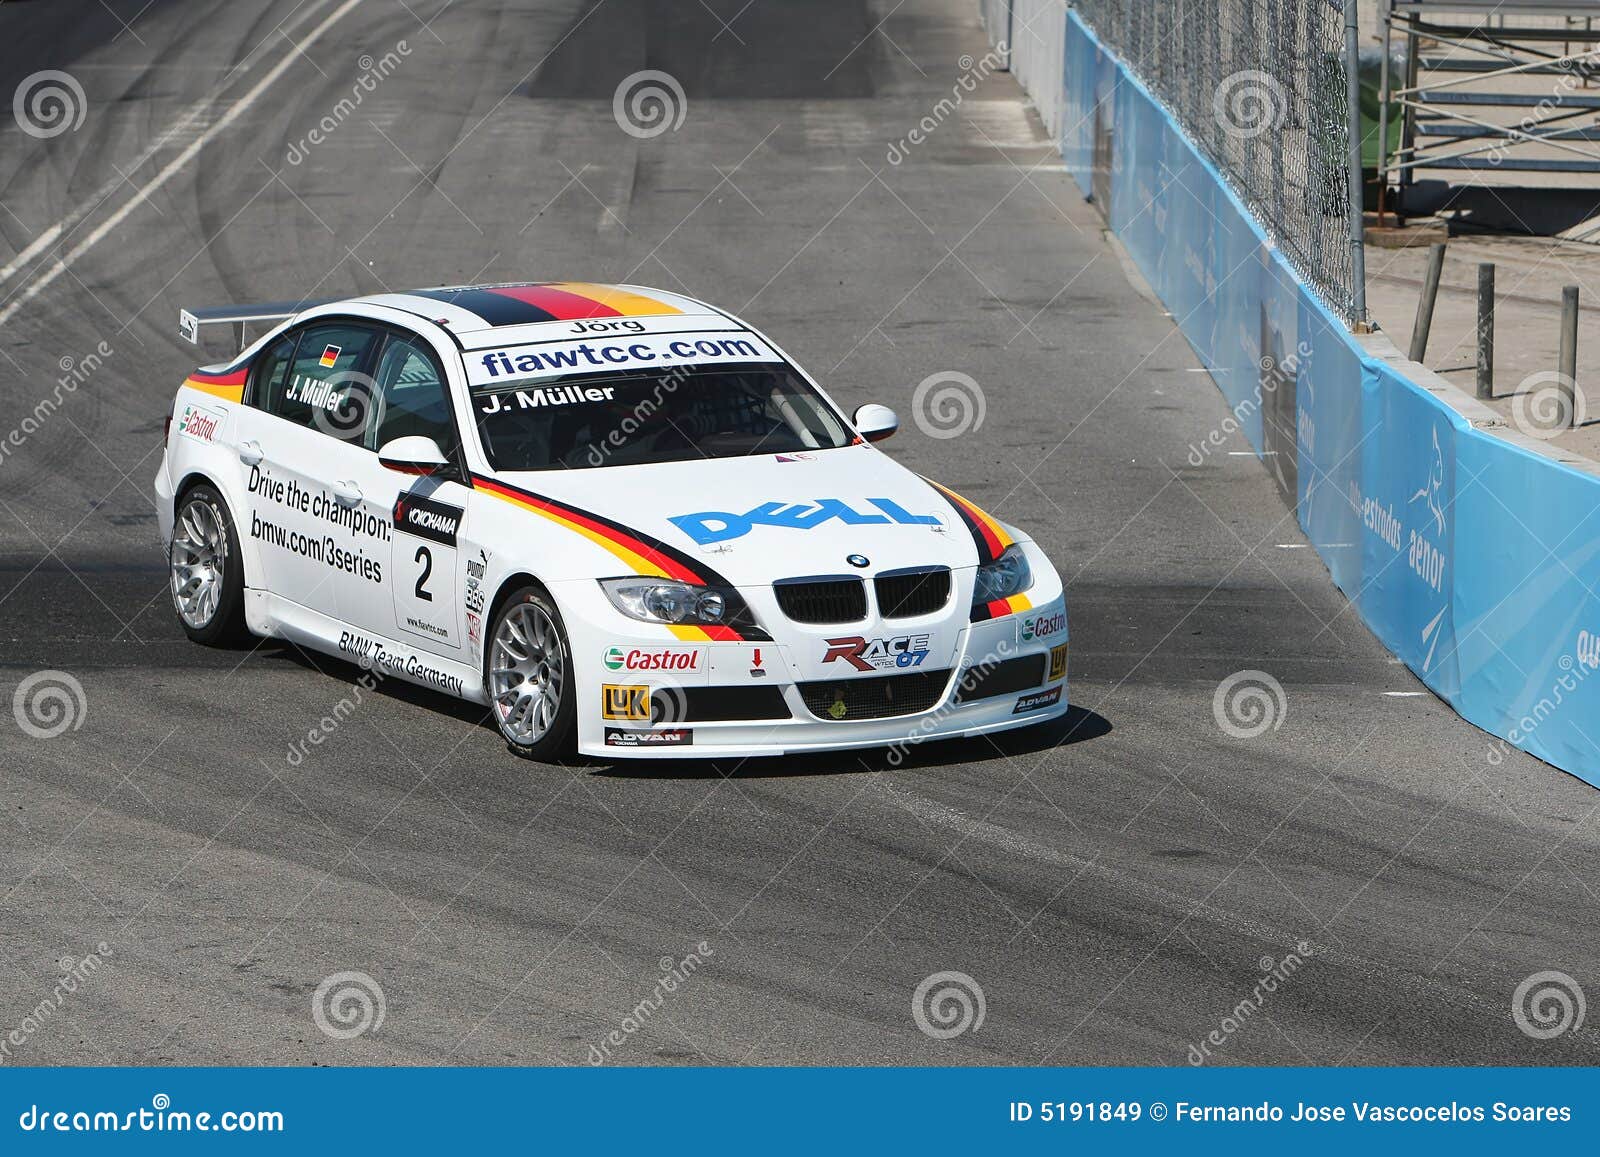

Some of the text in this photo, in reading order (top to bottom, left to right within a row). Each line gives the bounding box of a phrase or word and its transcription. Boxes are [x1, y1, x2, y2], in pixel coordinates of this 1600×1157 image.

[570, 318, 646, 333] Jörg
[481, 339, 760, 377] fiawtcc.com
[286, 377, 345, 412] J. Müller
[482, 385, 615, 414] J. Müller
[185, 410, 218, 442] Castrol
[248, 465, 391, 542] Drive the champion:
[408, 508, 457, 535] YOKOHAMA
[666, 498, 944, 545] DELL
[251, 510, 382, 583] bmw.com/3series
[1408, 528, 1446, 593] aenor
[414, 546, 433, 602] 2
[465, 585, 485, 613] BBS
[338, 631, 464, 697] BMW Team Germany
[626, 649, 698, 670] Castrol
[822, 633, 930, 672] RACE 07
[607, 733, 681, 741] ADVAN
